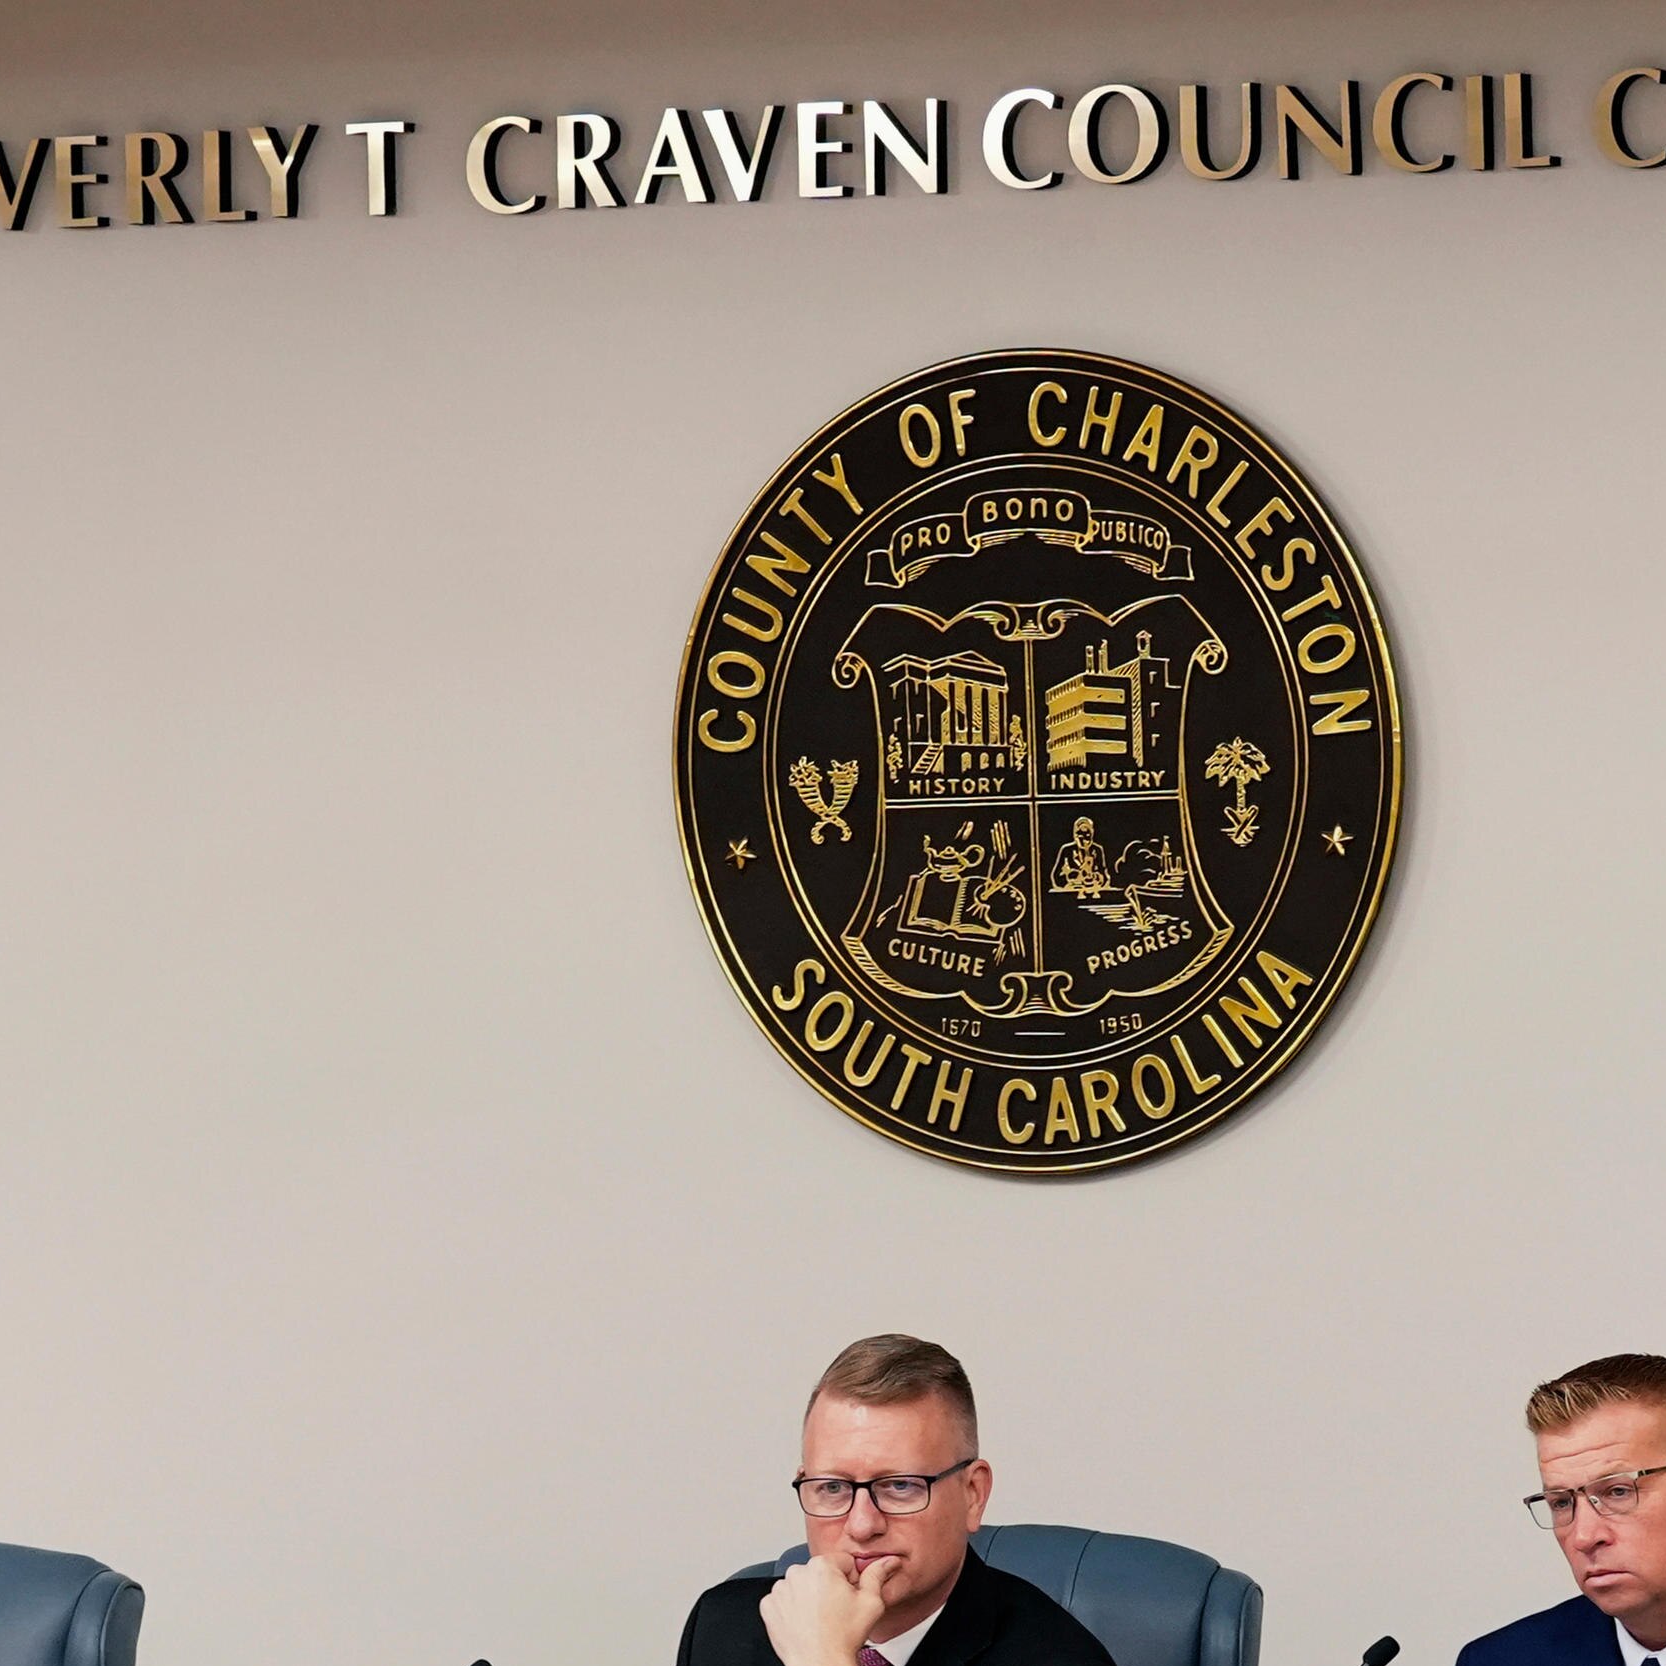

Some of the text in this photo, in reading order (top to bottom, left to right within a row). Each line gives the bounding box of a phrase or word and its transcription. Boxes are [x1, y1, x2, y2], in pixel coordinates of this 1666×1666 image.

[345, 121, 415, 216] T
[465, 96, 950, 215] CRAVEN
[982, 71, 1562, 190] COUNCIL
[899, 522, 951, 558] PRO
[1088, 519, 1165, 551] PUBLICO
[699, 381, 1372, 753] COUNTY OF CHARLESTON
[908, 776, 1006, 796] HISTORY
[1050, 769, 1166, 791] INDUSTRY
[887, 937, 985, 977] CULTURE
[1087, 920, 1193, 976] PROGRESS
[1099, 1013, 1143, 1034] 1950
[771, 947, 1313, 1146] SOUTH CAROLINA
